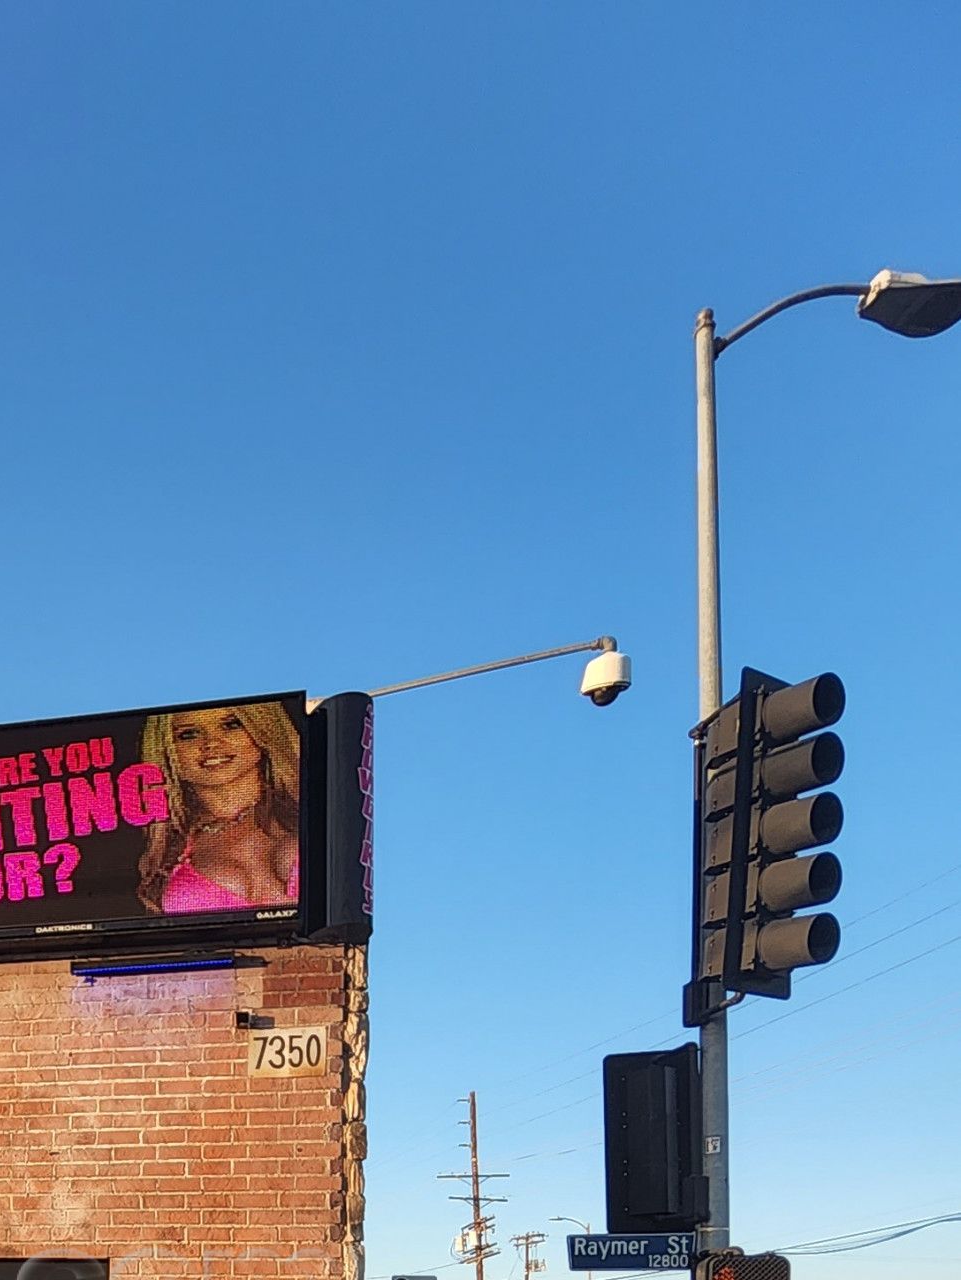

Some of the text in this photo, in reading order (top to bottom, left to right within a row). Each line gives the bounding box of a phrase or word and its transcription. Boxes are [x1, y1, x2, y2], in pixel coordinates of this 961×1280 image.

[42, 737, 115, 777] YOU
[34, 922, 94, 935] DAKTRONICS
[253, 1033, 322, 1070] 7350
[573, 1235, 690, 1261] Raymer St
[647, 1254, 689, 1268] 12800
